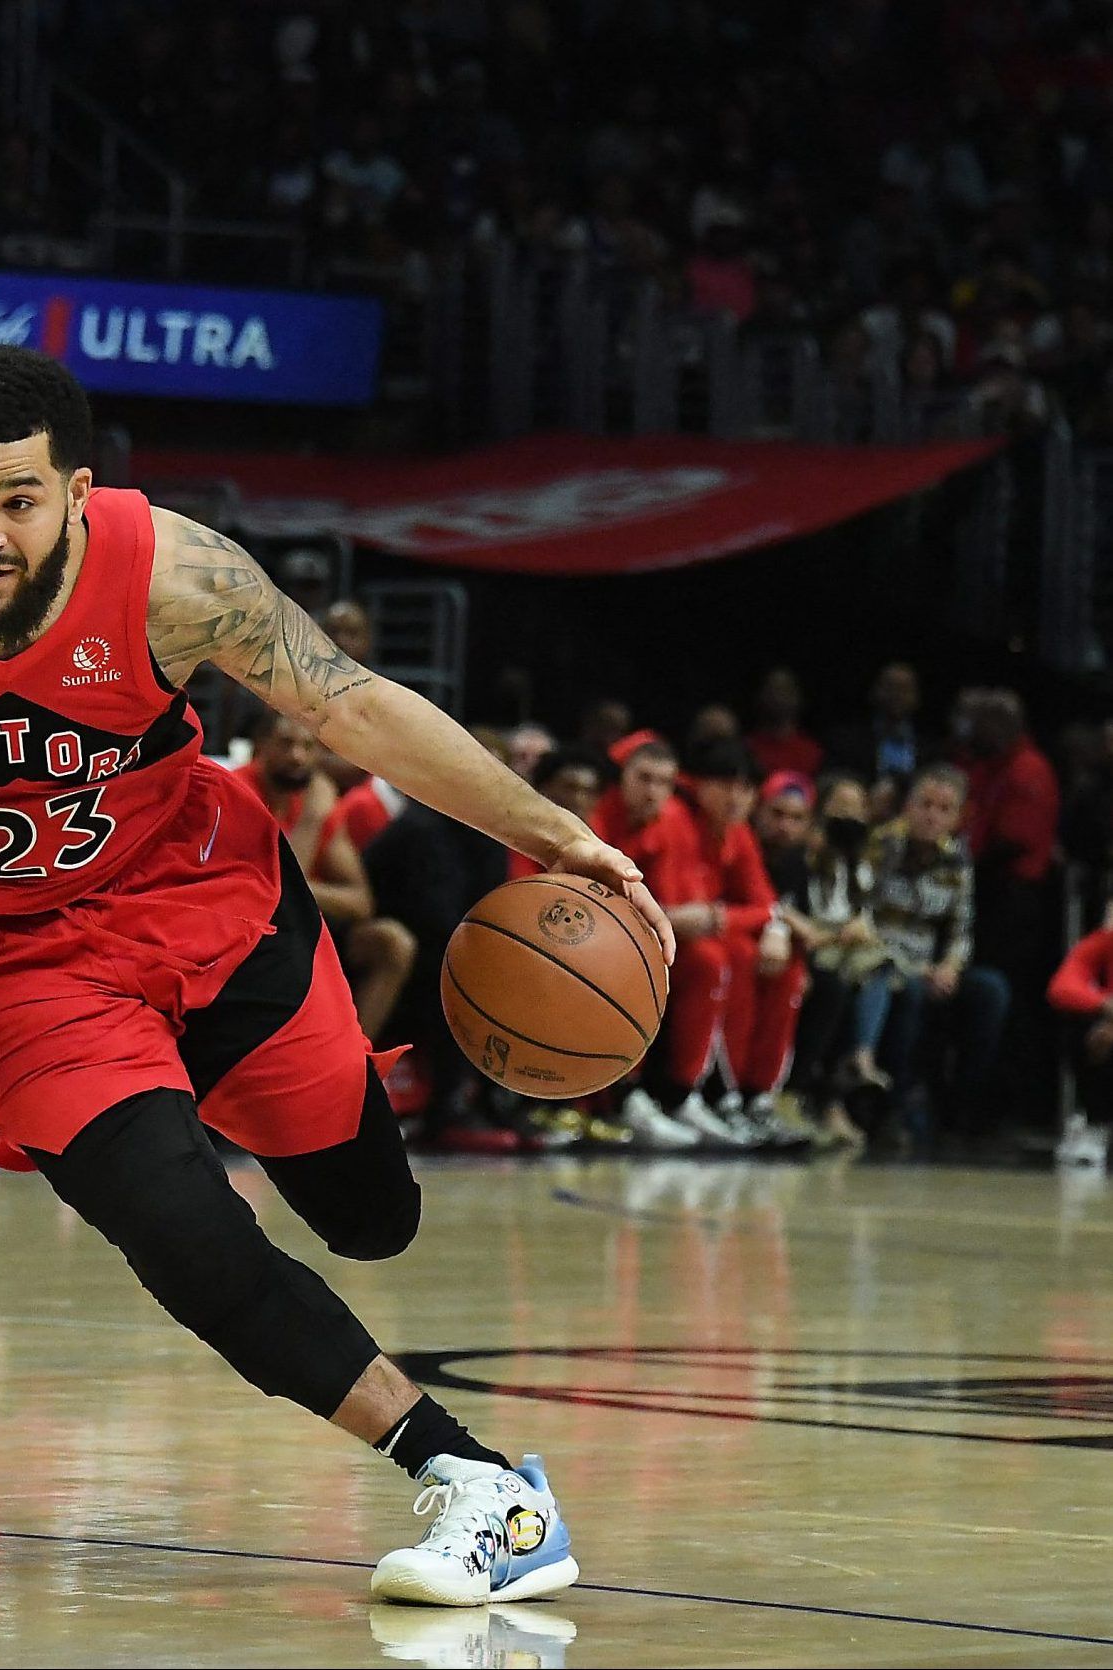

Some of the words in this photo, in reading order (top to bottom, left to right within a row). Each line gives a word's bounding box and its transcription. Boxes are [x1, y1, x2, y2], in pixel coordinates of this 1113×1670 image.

[79, 305, 275, 371] ULTRA
[61, 674, 91, 688] Sun
[93, 669, 122, 684] Life
